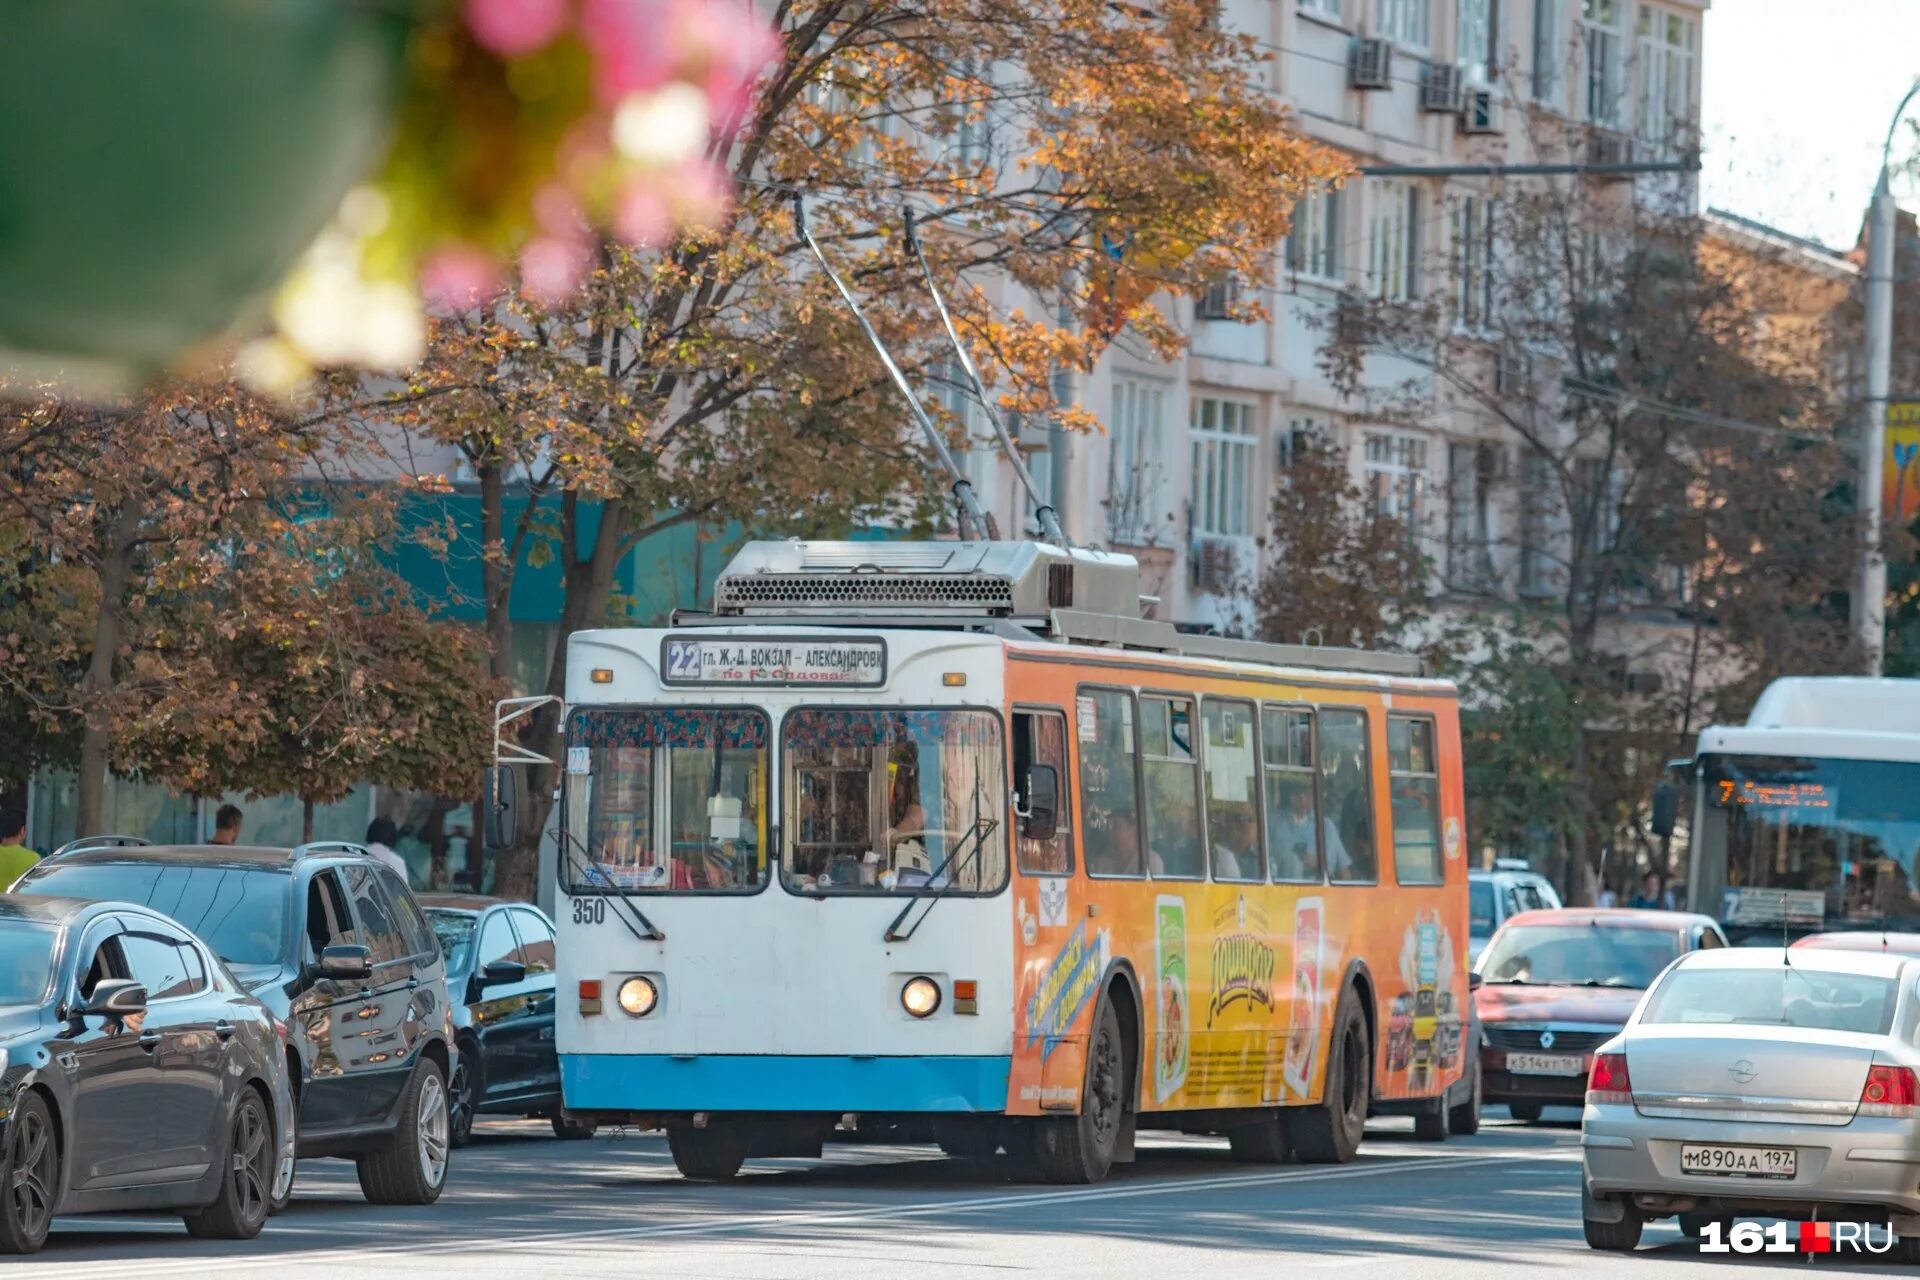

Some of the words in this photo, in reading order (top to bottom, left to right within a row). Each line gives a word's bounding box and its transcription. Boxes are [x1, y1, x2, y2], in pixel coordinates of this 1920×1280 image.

[670, 643, 700, 676] 22
[703, 652, 716, 665] гл.
[751, 648, 791, 666] ВОКЗАЛ
[1718, 780, 1735, 801] 7
[573, 899, 605, 924] 350
[1688, 1150, 1759, 1169] М890АА
[1764, 1151, 1790, 1166] 197
